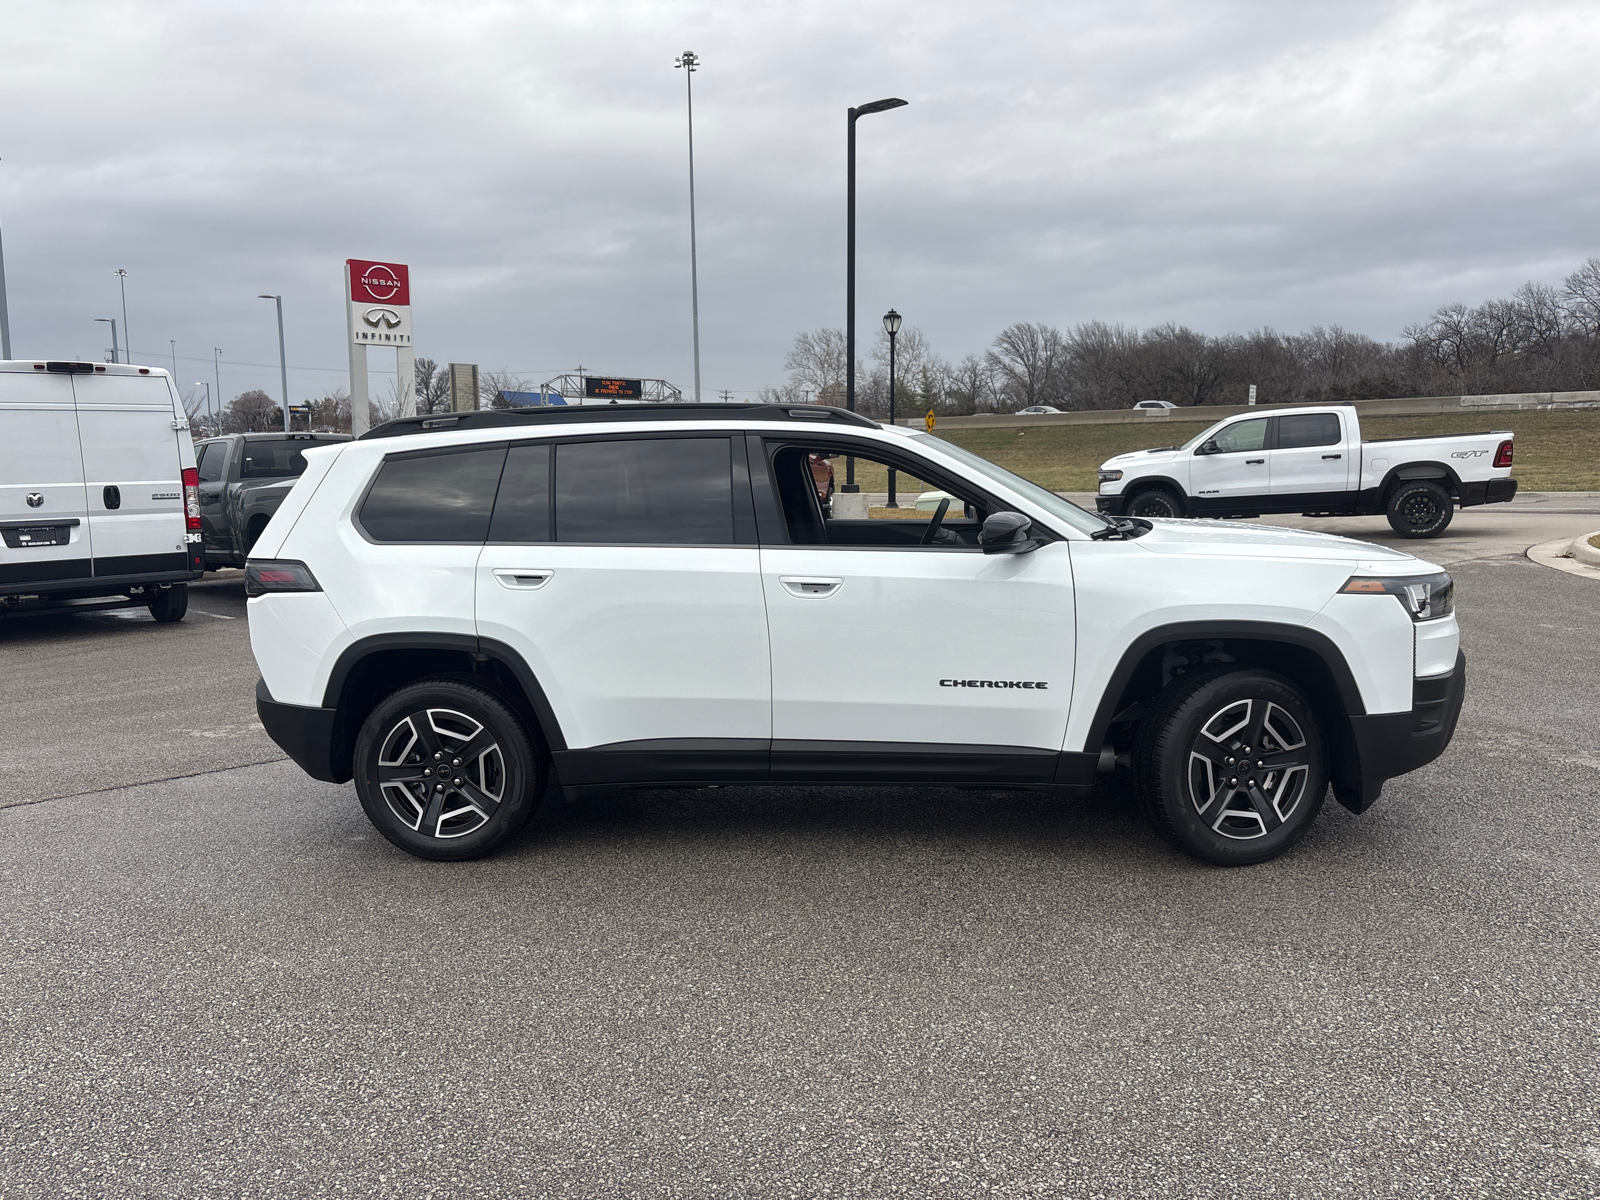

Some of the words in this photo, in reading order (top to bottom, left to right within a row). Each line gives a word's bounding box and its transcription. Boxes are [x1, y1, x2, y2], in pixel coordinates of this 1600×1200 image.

[361, 277, 401, 287] NISSAN
[355, 331, 411, 342] INFINITI
[939, 679, 1048, 690] CHEROKEE
